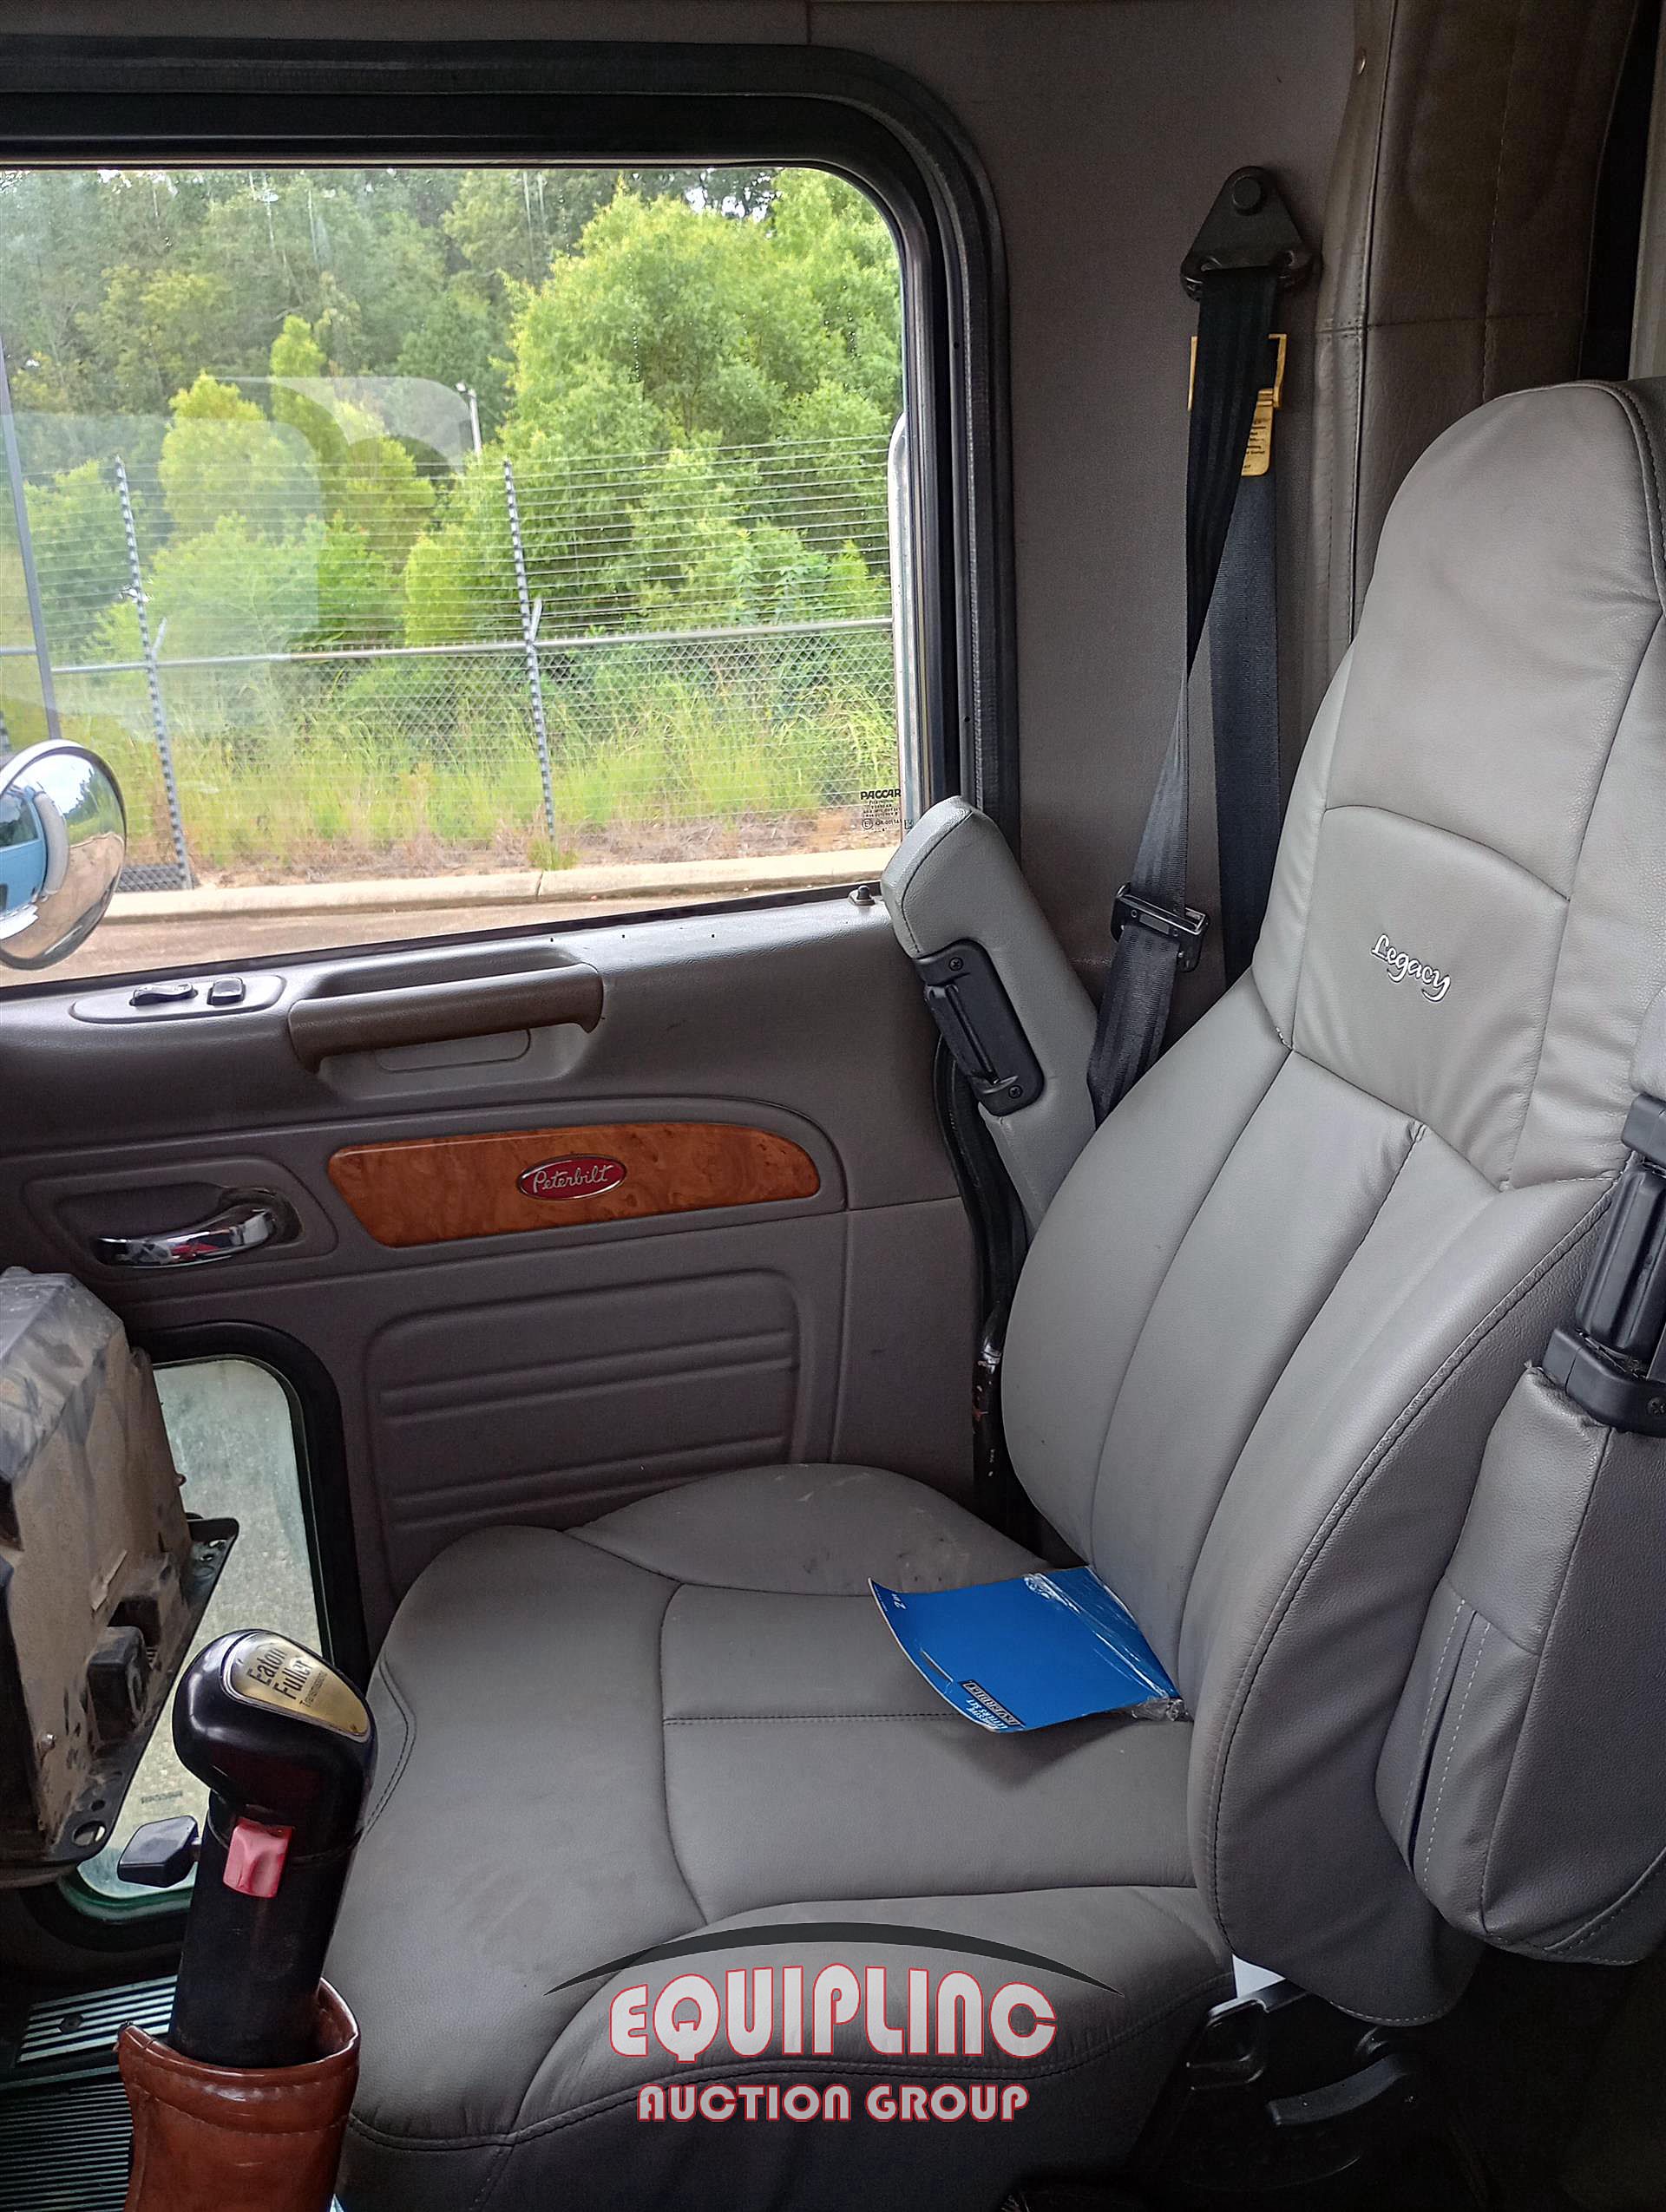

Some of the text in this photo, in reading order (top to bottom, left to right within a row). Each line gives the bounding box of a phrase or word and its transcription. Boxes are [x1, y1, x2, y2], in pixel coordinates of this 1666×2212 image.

[860, 789, 902, 800] PACCAR
[1370, 933, 1451, 1002] Legacy
[533, 1164, 614, 1194] Peterbilt
[246, 1648, 287, 1686] Eaton
[272, 1659, 313, 1700] Fuller
